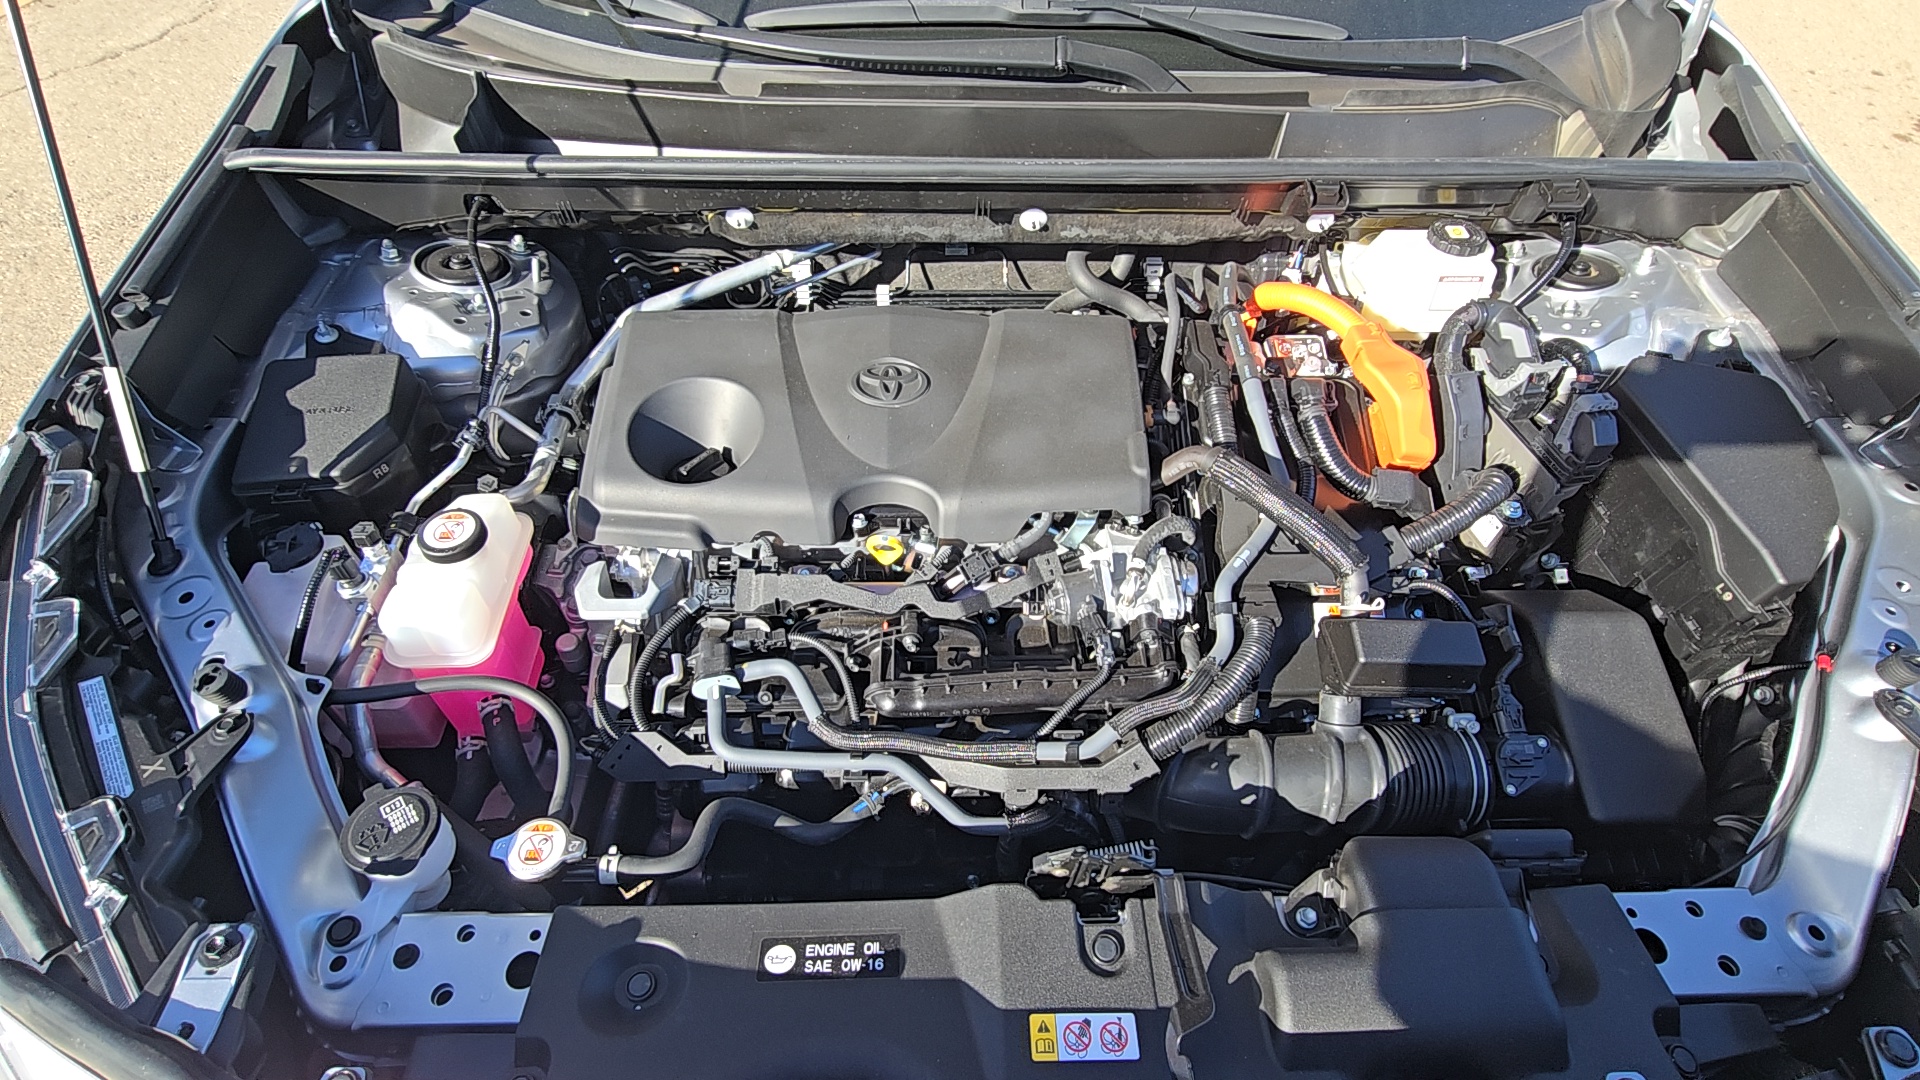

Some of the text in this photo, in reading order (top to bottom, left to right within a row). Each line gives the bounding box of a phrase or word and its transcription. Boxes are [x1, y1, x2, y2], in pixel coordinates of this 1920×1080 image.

[805, 942, 885, 957] ENGINE OIL
[804, 960, 832, 973] SAE
